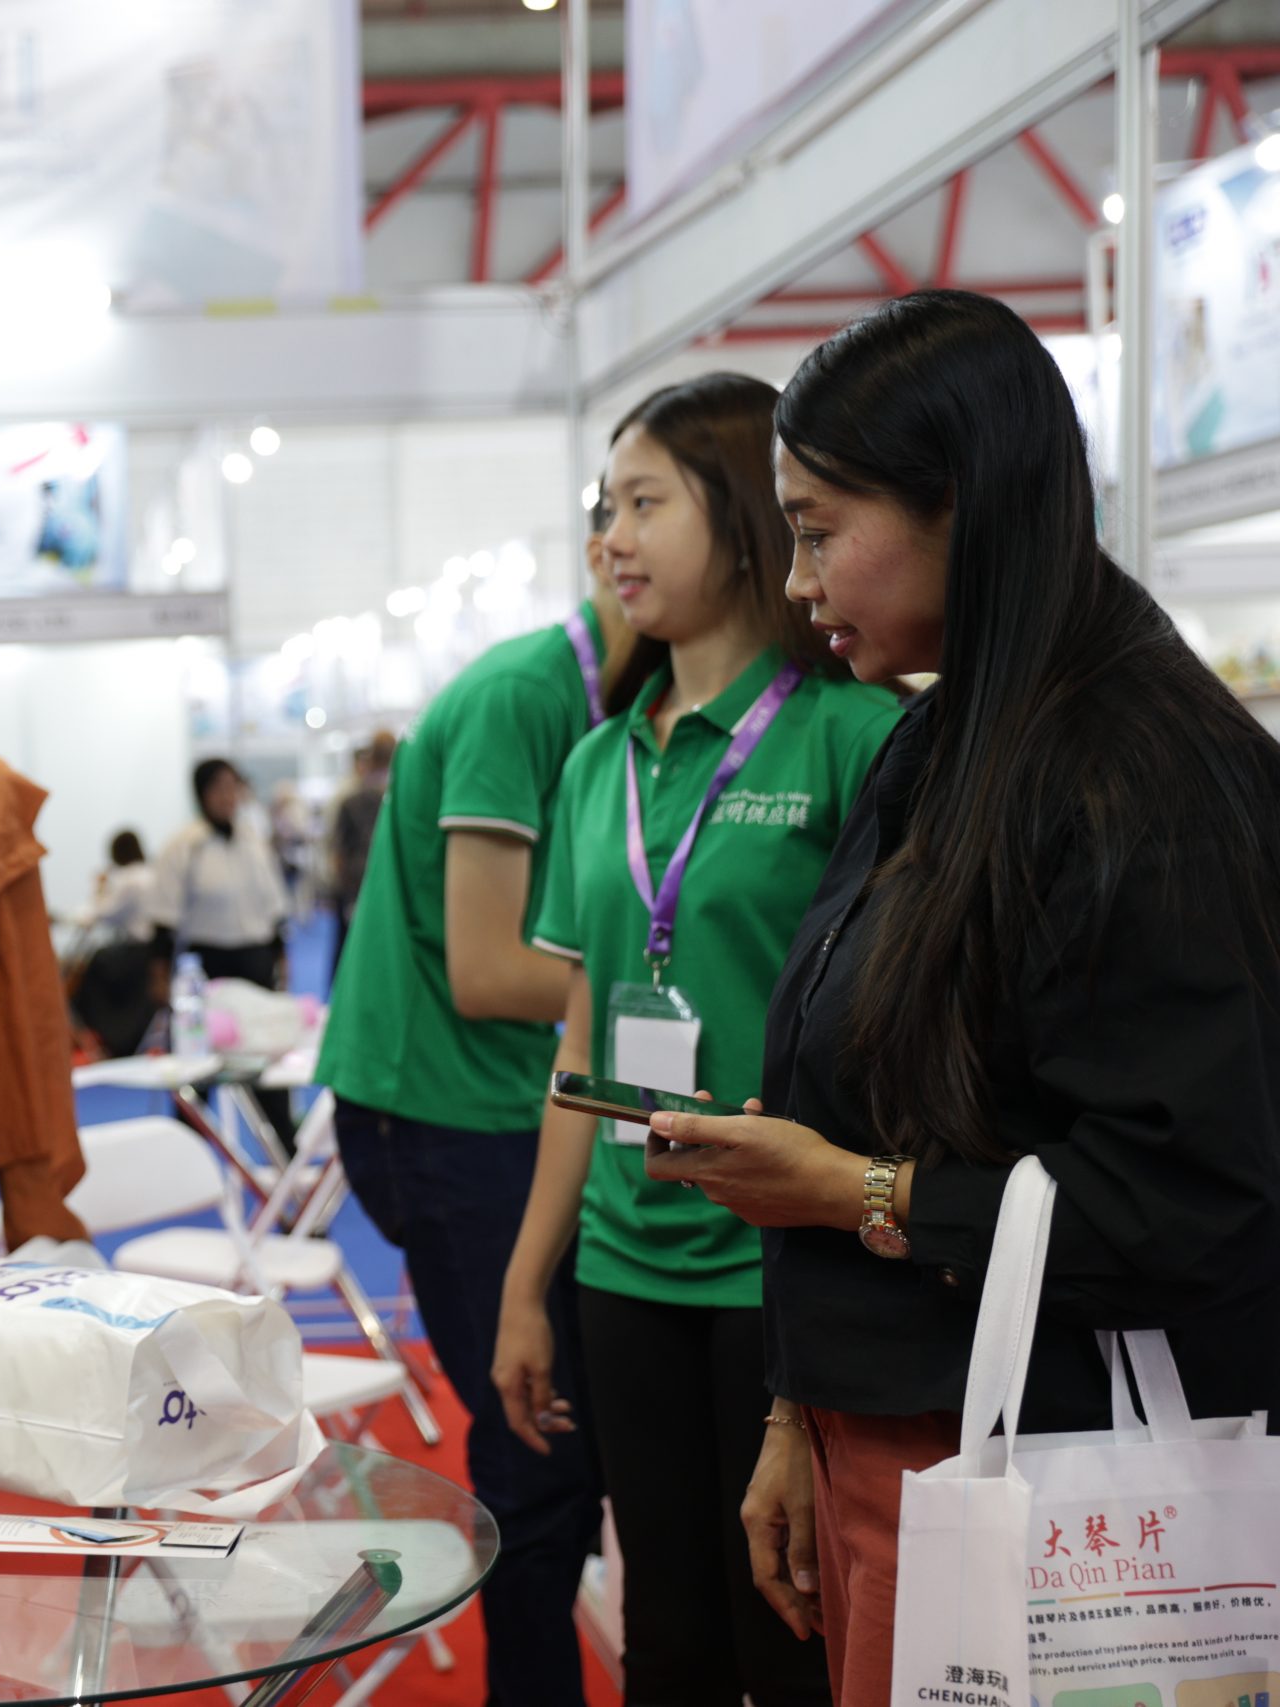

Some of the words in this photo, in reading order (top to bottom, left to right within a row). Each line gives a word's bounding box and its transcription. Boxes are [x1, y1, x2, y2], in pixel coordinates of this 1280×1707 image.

[1028, 1566, 1065, 1590] Da
[1070, 1560, 1107, 1592] Qin
[1114, 1556, 1177, 1583] Pian
[1044, 1649, 1094, 1661] production
[1095, 1647, 1103, 1655] of
[1116, 1644, 1138, 1655] piano
[1140, 1641, 1169, 1653] pieces
[1172, 1640, 1189, 1648] and
[1192, 1639, 1203, 1648] all
[1205, 1636, 1224, 1646] kinds
[1225, 1634, 1233, 1643] of
[1234, 1632, 1279, 1642] hardware
[1053, 1665, 1075, 1676] good
[1077, 1662, 1107, 1672] service
[1108, 1660, 1121, 1669] and
[1121, 1658, 1139, 1669] high
[1140, 1656, 1167, 1667] price.
[1168, 1653, 1209, 1664] Welcome
[1210, 1652, 1219, 1660] to
[1220, 1649, 1235, 1658] visit
[1237, 1648, 1247, 1657] us
